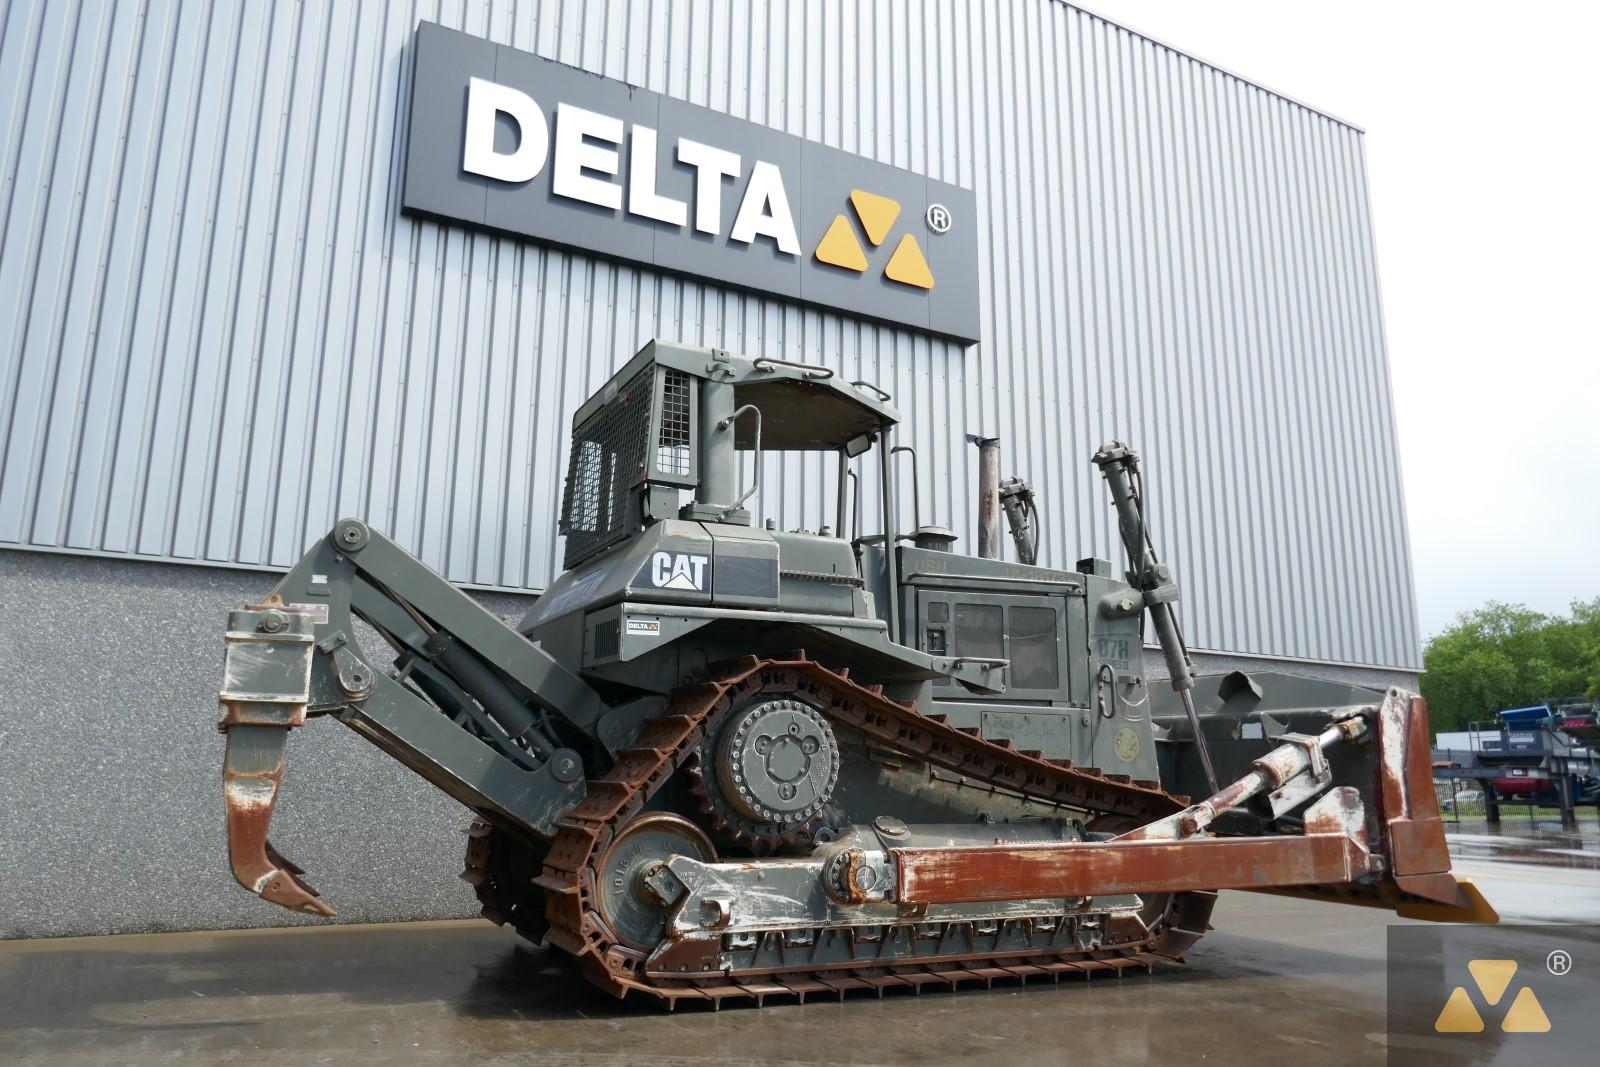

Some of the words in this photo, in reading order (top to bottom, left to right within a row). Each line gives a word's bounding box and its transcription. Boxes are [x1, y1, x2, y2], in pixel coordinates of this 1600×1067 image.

[463, 77, 802, 256] DELTA
[652, 551, 708, 591] CAT
[913, 559, 946, 574] USN
[1098, 638, 1129, 659] D7H
